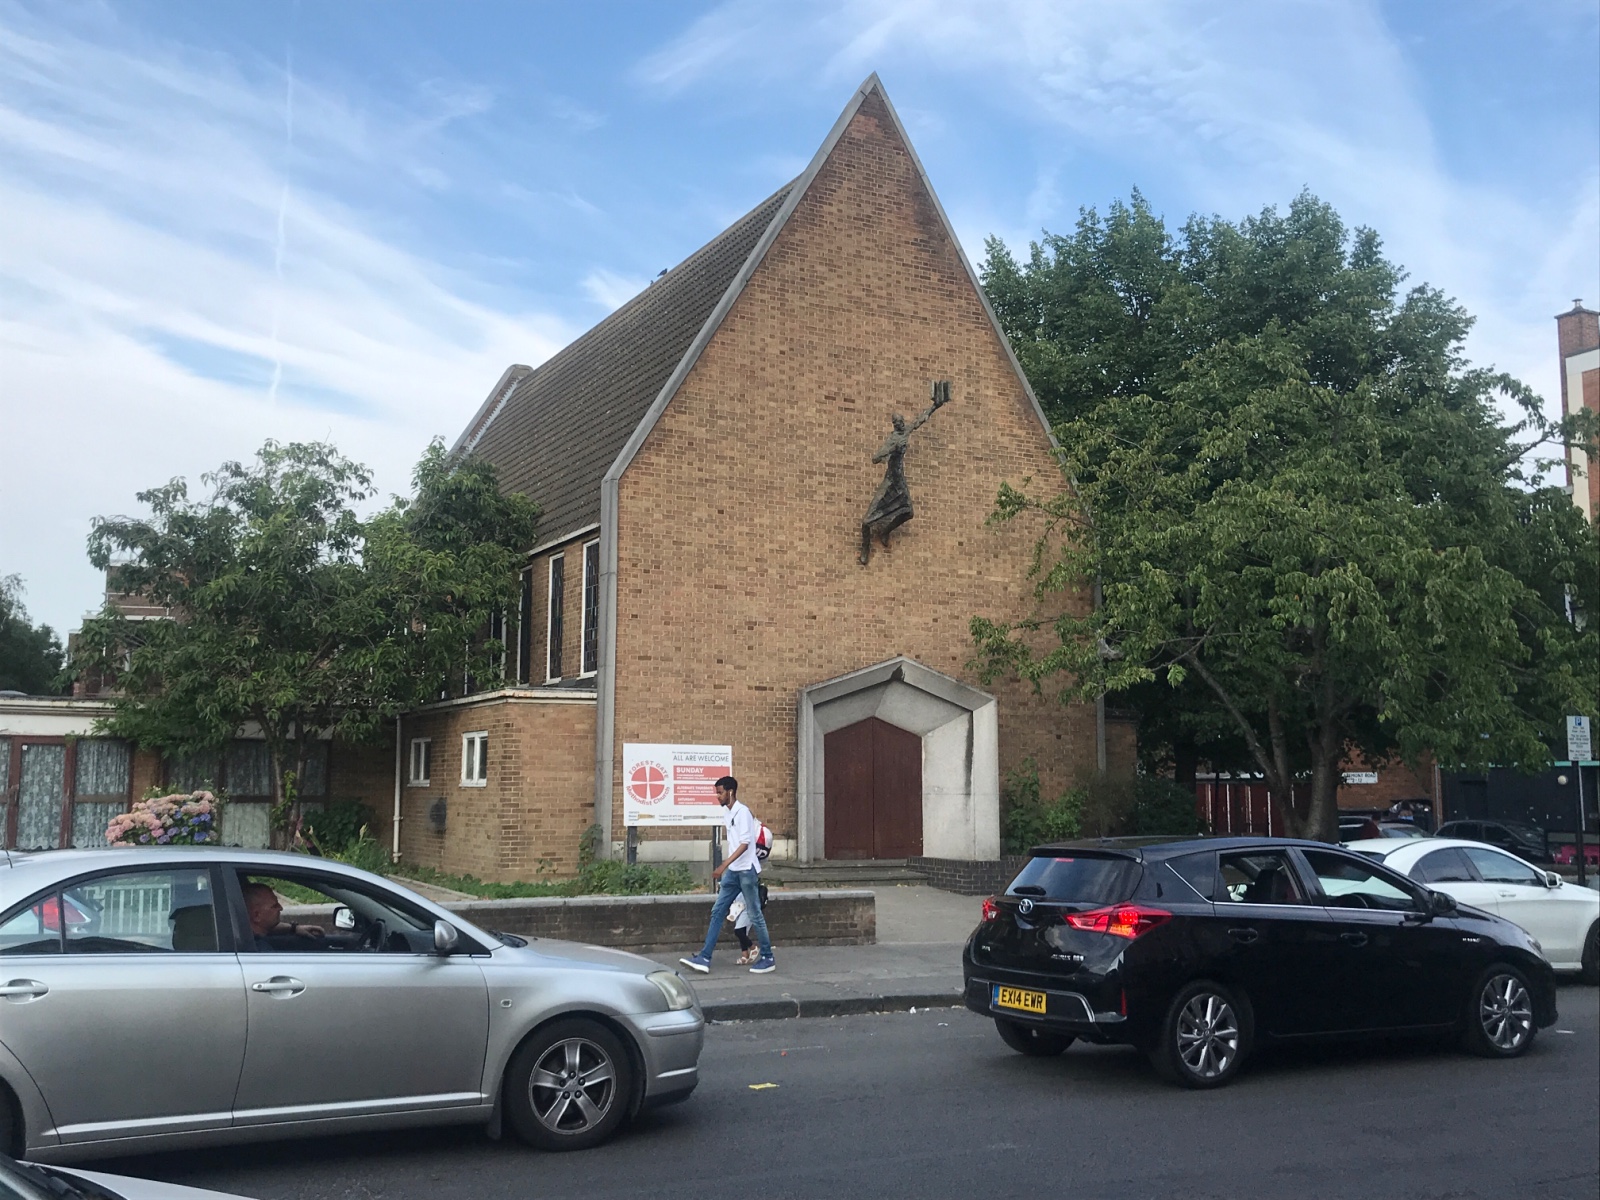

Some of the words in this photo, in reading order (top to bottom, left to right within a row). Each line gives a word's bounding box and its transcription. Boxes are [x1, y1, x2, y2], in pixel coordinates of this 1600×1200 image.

[628, 760, 654, 775] FOREST
[655, 763, 669, 778] GATE
[625, 785, 652, 805] Methodist
[653, 786, 670, 805] Church
[1001, 989, 1022, 1005] EX14
[1024, 992, 1043, 1009] EWR
